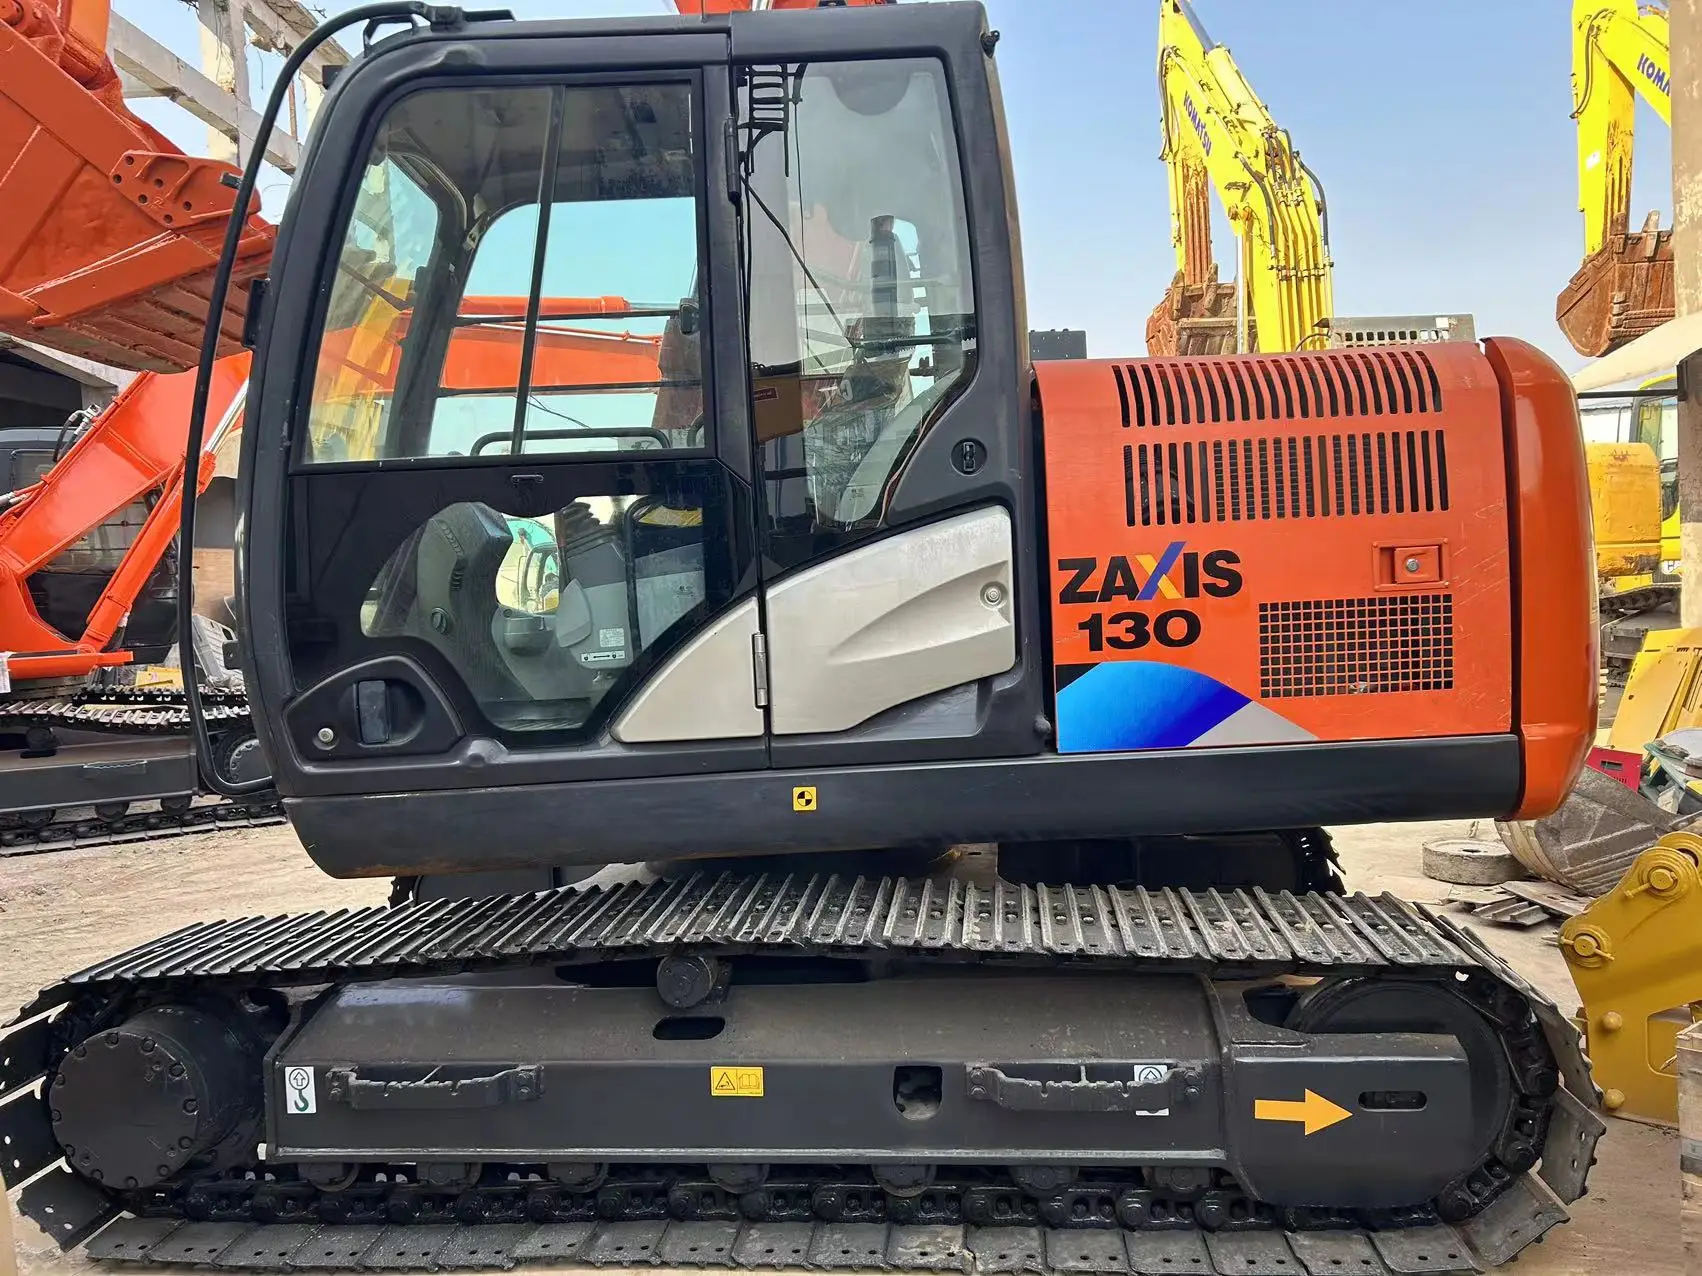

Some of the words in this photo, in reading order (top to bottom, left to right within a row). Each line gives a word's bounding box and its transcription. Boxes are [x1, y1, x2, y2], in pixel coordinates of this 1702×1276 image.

[1183, 90, 1212, 157] KOMATSU
[1058, 541, 1243, 604] ZAXIS
[1078, 609, 1201, 652] 130
